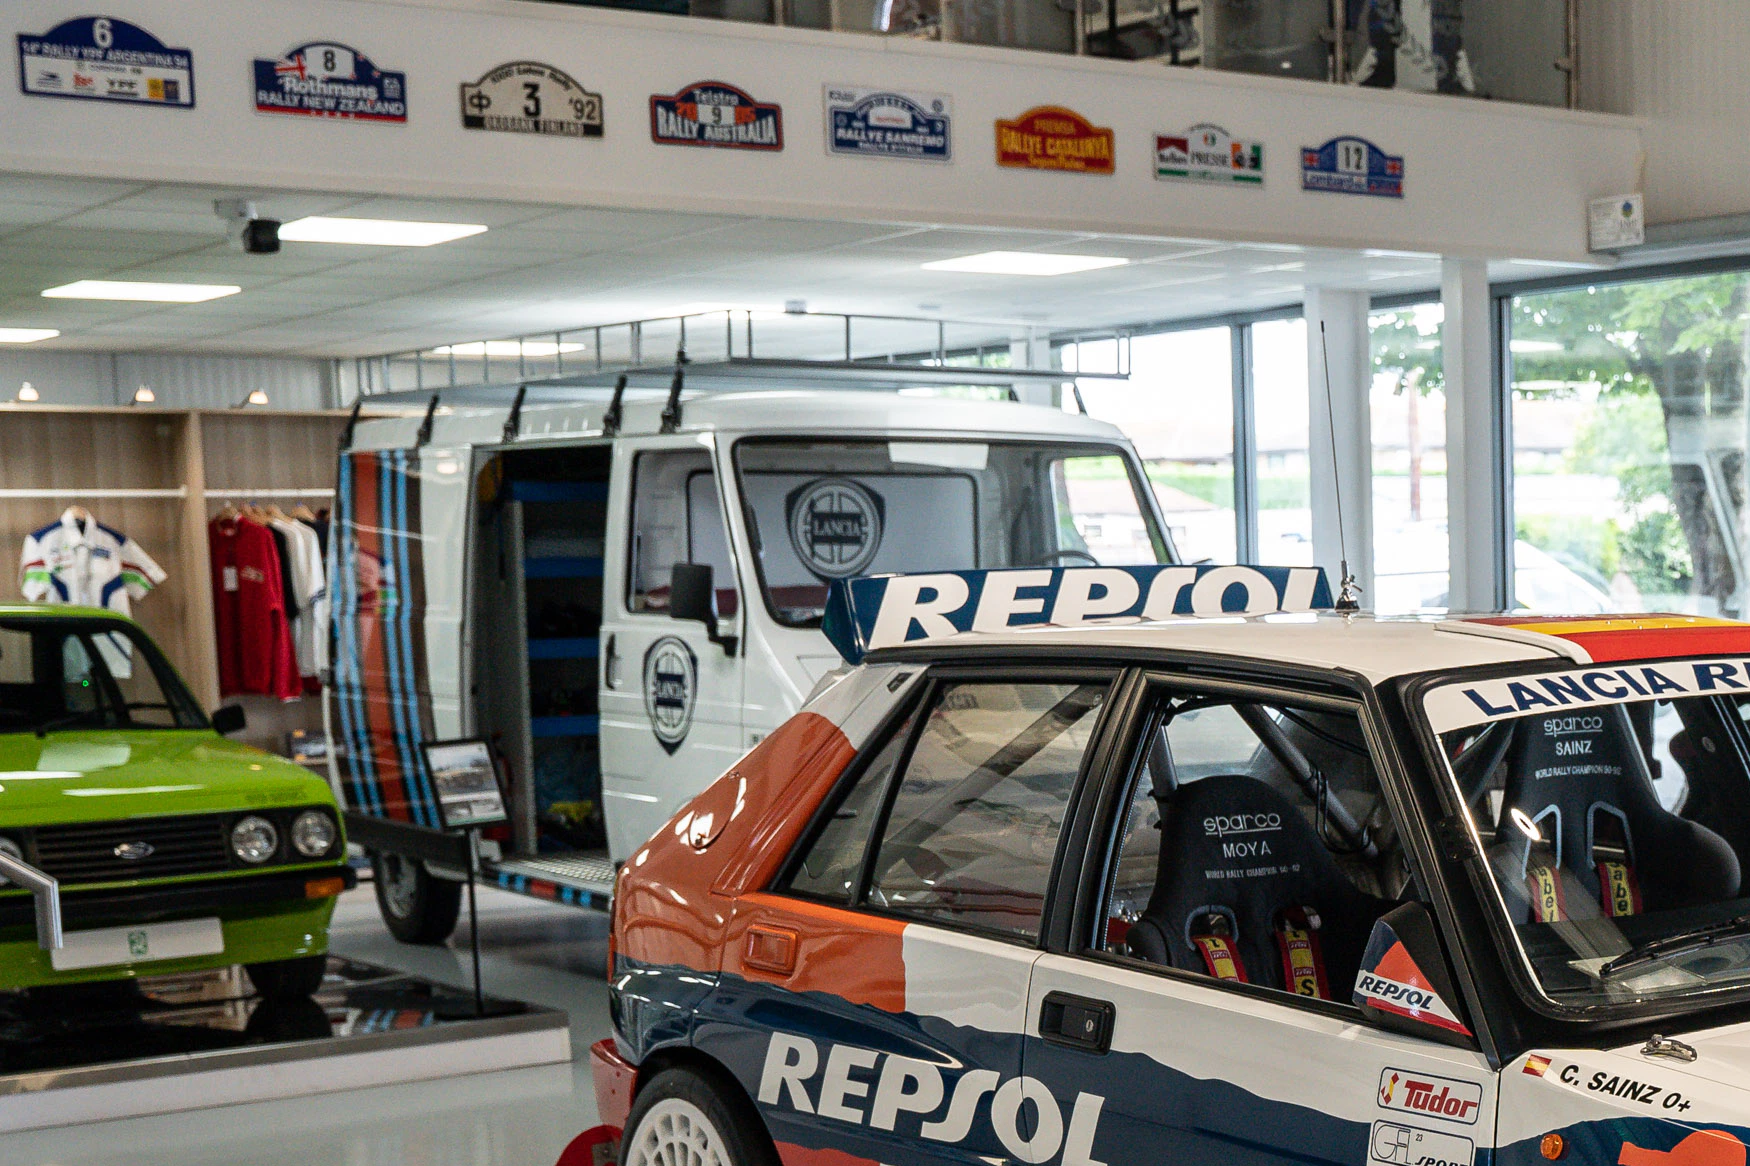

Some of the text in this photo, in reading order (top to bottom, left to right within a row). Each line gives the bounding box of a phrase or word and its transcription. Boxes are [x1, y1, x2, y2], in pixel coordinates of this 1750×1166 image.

[92, 18, 114, 49] 6
[323, 50, 336, 72] 8
[280, 75, 378, 100] Rothmans
[523, 82, 542, 117] 3
[257, 90, 300, 106] RALLY
[303, 95, 337, 110] NEW
[339, 99, 405, 116] ZEALAND
[711, 107, 722, 125] 9
[657, 104, 777, 145] RALLY AUSTRALIA
[1344, 145, 1363, 170] 12
[813, 521, 861, 537] LANCIA
[868, 566, 1320, 650] REPSOL
[1461, 667, 1689, 717] LANCIA
[1544, 716, 1603, 738] sparco
[1555, 740, 1593, 756] SAINZ
[1203, 812, 1282, 838] sparco
[1222, 841, 1272, 859] MOYA
[1358, 975, 1436, 1010] REPSOL
[1560, 1064, 1580, 1086] C.
[1587, 1072, 1663, 1104] SAINZ
[1404, 1079, 1478, 1118] Tudor
